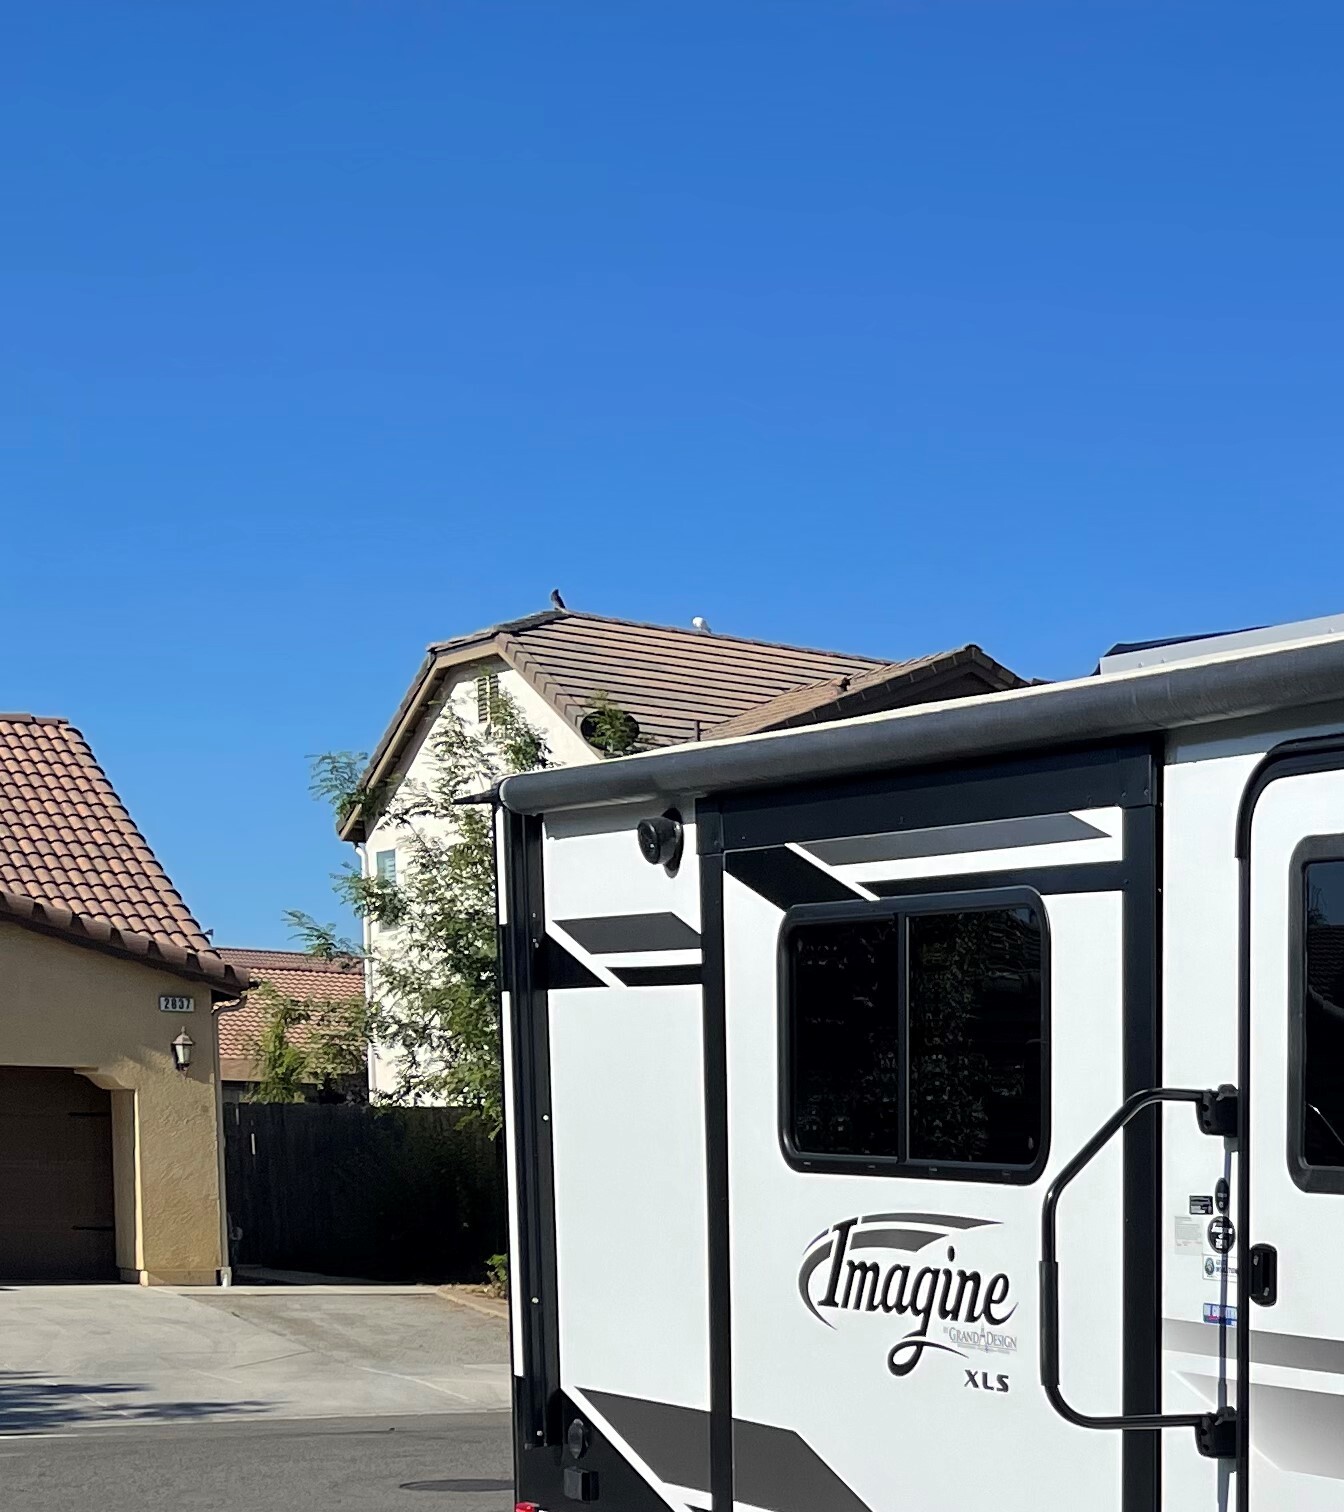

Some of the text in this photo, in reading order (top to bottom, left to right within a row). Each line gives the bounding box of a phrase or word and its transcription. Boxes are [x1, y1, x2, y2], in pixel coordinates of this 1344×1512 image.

[816, 1216, 1019, 1377] Imagine
[949, 1327, 980, 1344] GRAND
[986, 1331, 1017, 1349] DESIGN
[964, 1369, 1009, 1393] XLS
